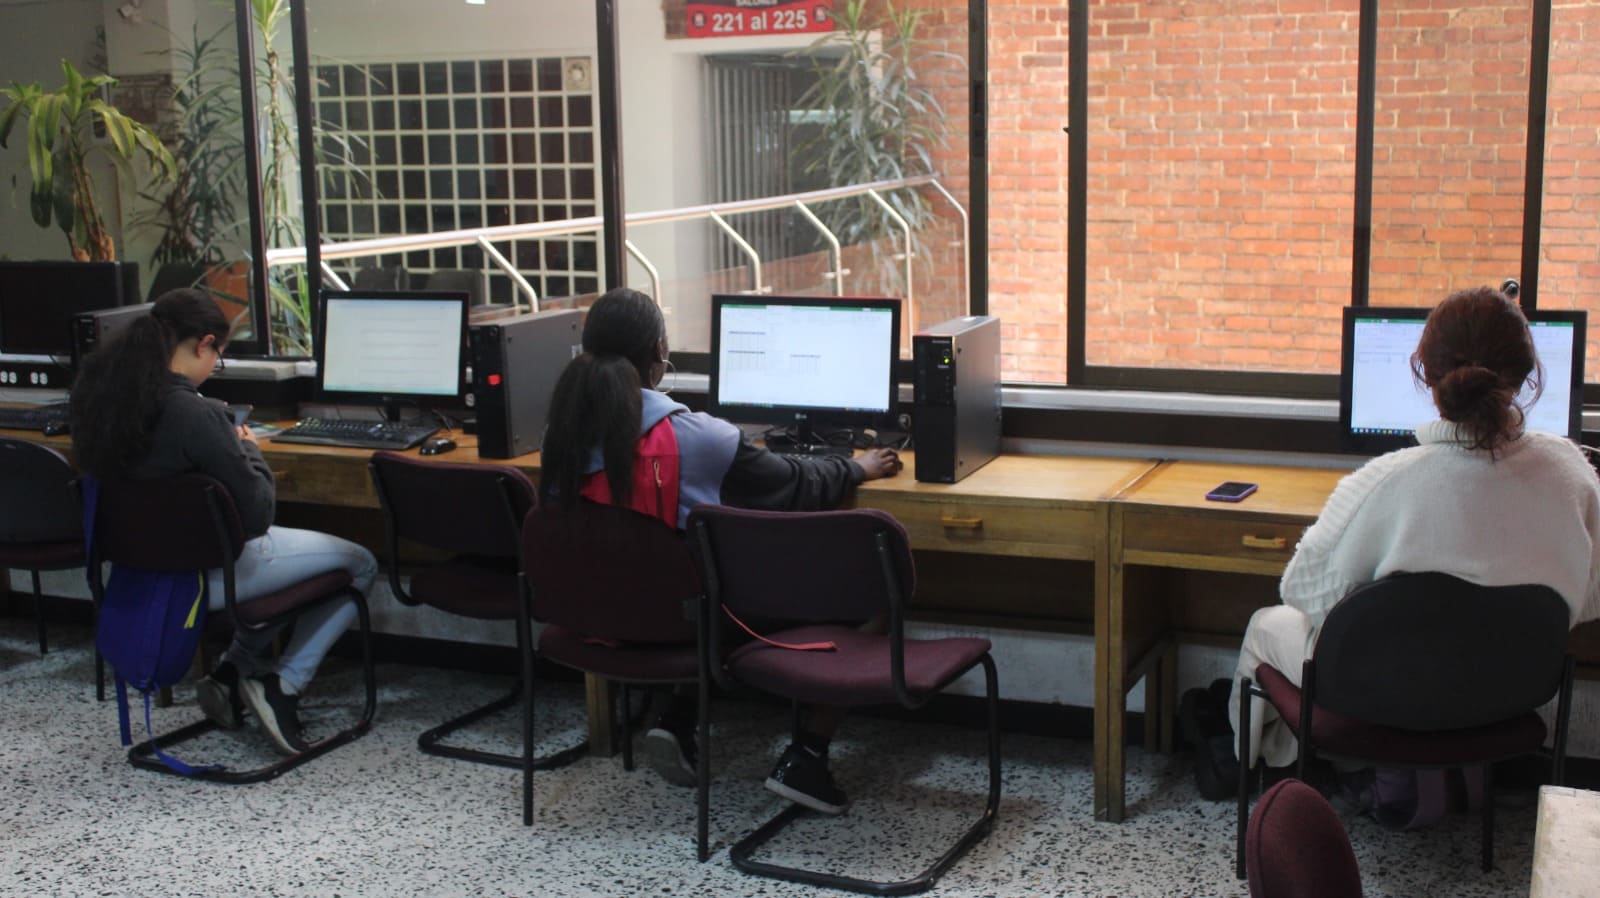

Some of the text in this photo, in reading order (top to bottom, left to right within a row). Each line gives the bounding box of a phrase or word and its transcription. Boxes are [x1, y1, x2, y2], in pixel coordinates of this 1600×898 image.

[711, 12, 744, 32] 221
[750, 11, 767, 30] al
[773, 9, 807, 30] 225
